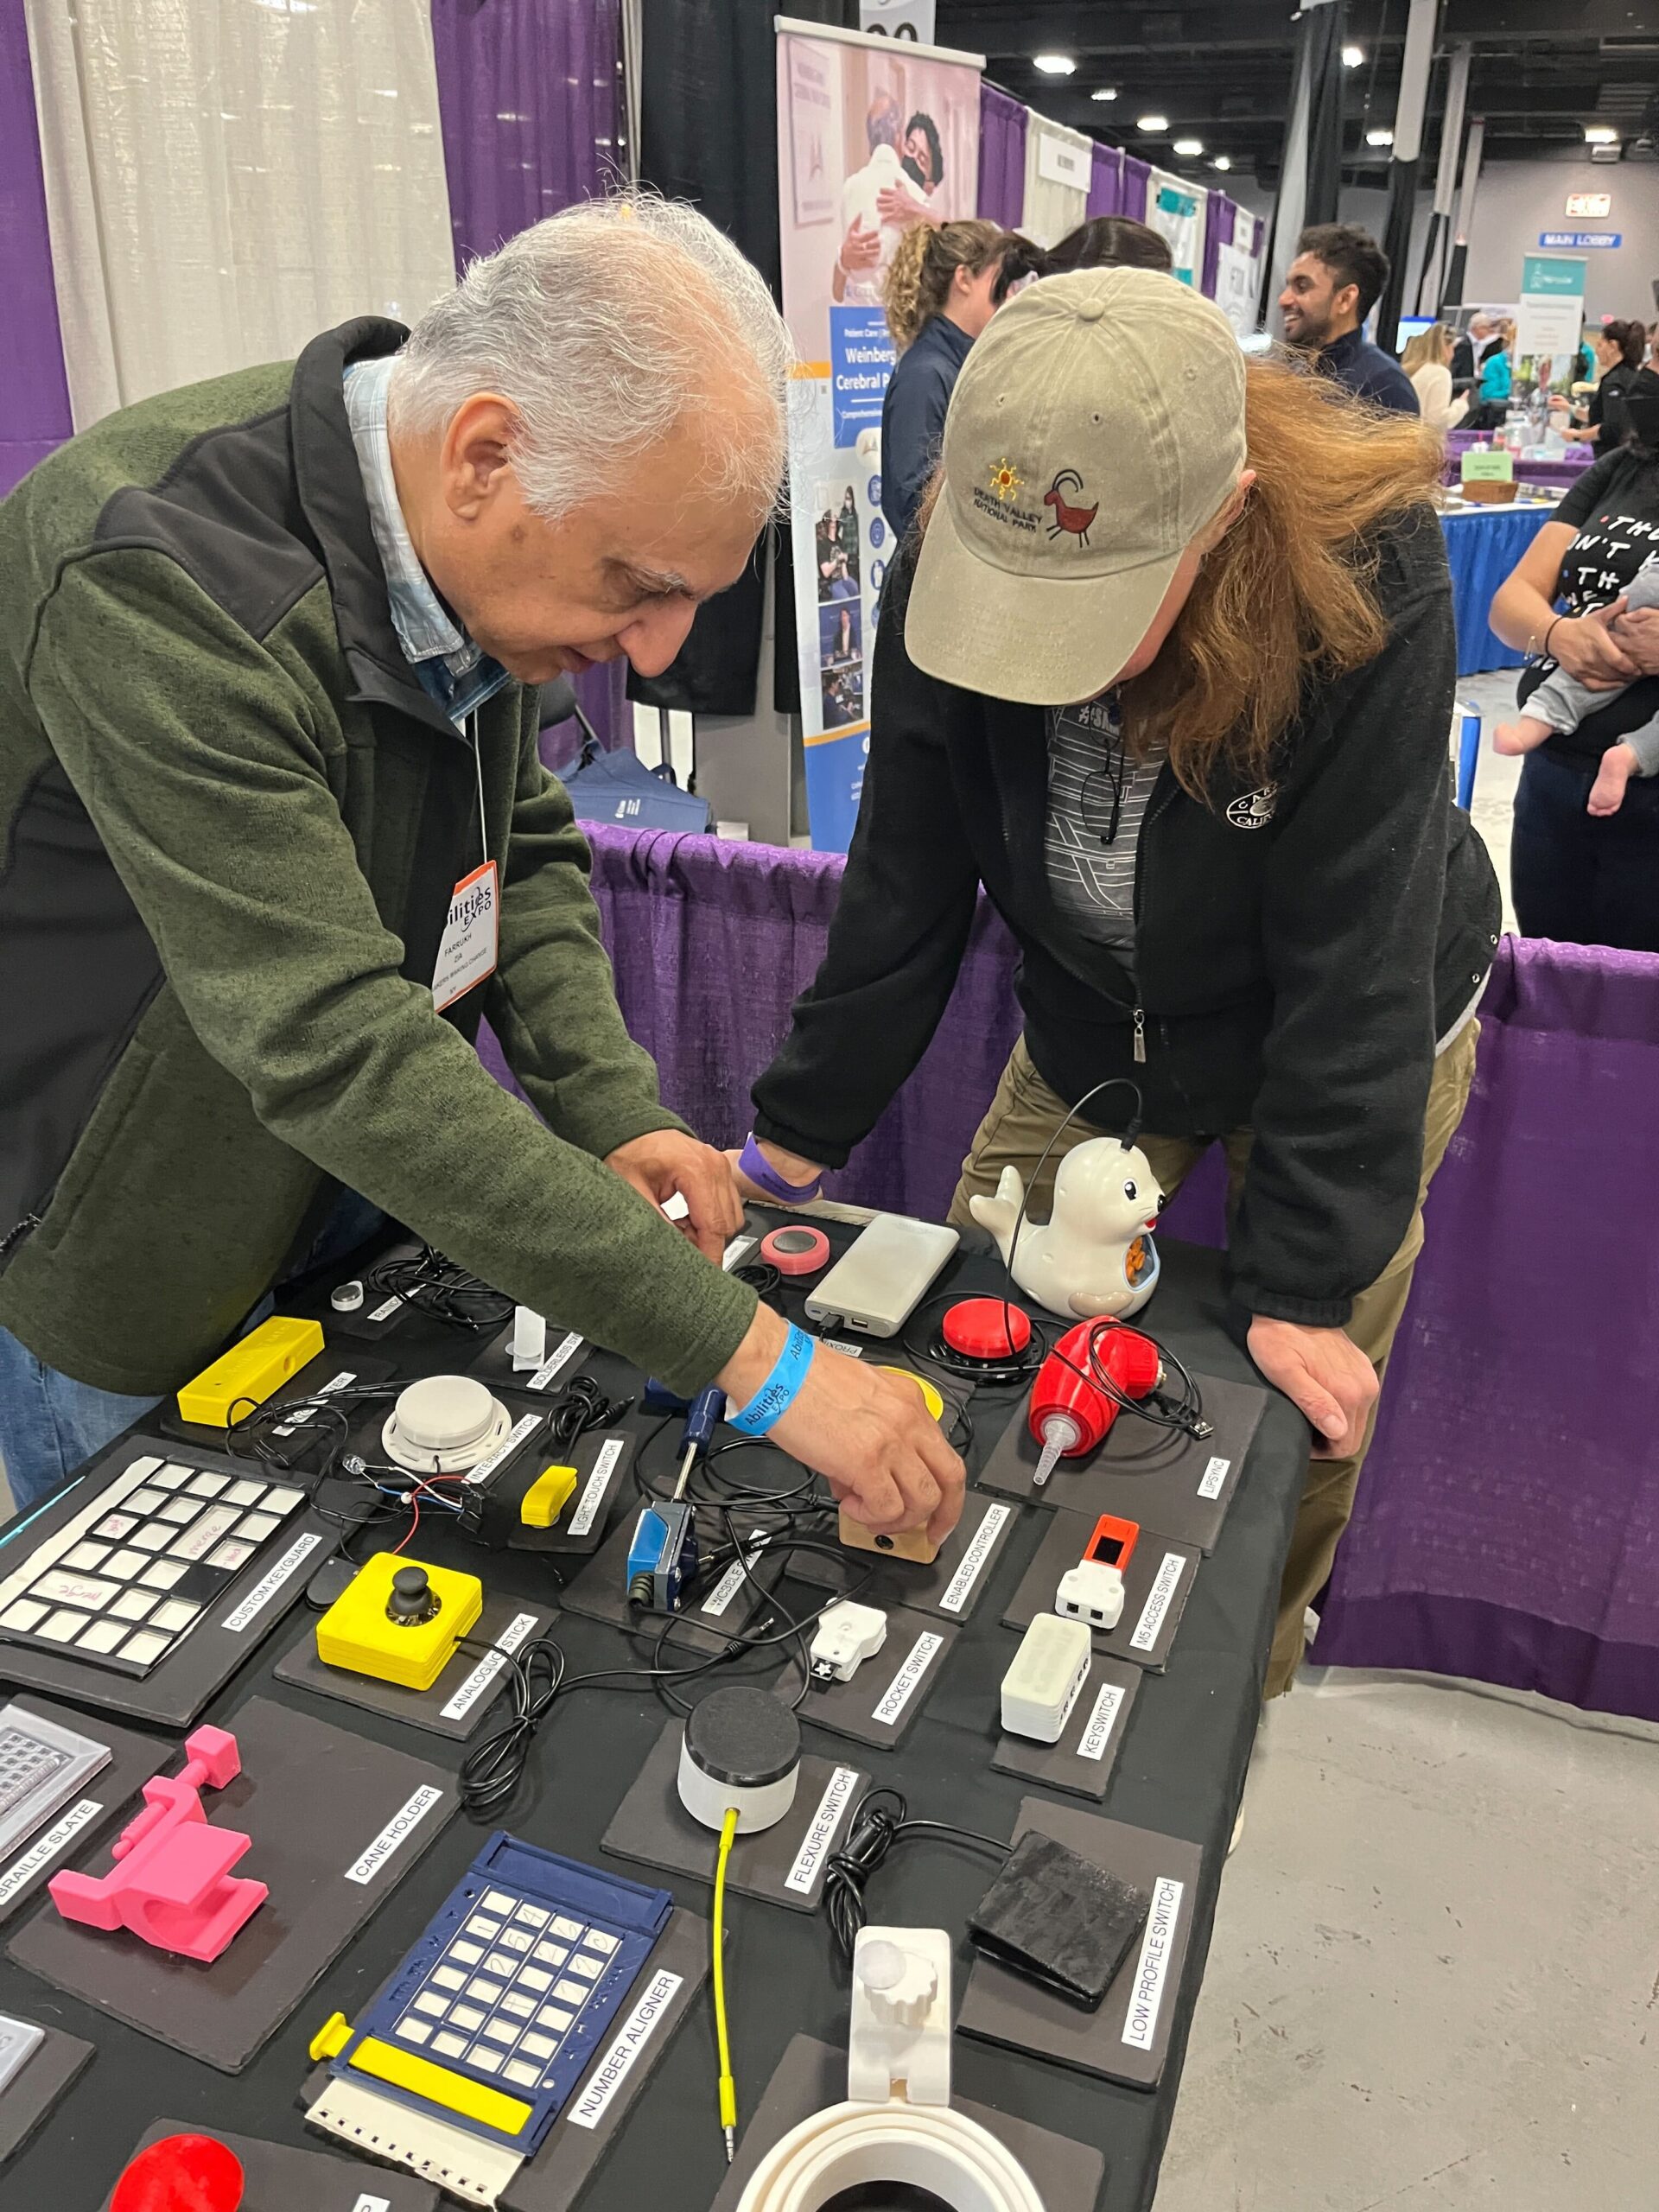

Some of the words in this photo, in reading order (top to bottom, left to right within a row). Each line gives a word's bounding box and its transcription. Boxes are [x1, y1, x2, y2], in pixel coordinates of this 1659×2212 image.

[1544, 234, 1573, 245] MAIN
[1577, 235, 1616, 246] LOBBY
[845, 346, 896, 365] Weinberg
[836, 372, 880, 390] Cerebral
[974, 487, 1001, 507] DEATH
[1003, 503, 1043, 524] VALLEY
[974, 499, 1007, 523] NATIONAL
[1013, 518, 1036, 532] PARK
[464, 900, 492, 925] EXPO
[533, 1343, 572, 1386] SOLDERLESS
[745, 1383, 784, 1426] Abilities
[771, 1389, 790, 1412] EXPO
[506, 1416, 537, 1443] SWITCH
[575, 1503, 590, 1530] LIGHT
[586, 1474, 603, 1509] TOUCH
[598, 1445, 617, 1476] SWITCH
[1203, 1460, 1224, 1493] LIPSYNC
[946, 1564, 976, 1605] ENABLED
[968, 1508, 1003, 1563] CONTROLLER
[1157, 1559, 1179, 1593] SWITCH
[230, 1586, 272, 1627] CUSTOM
[267, 1536, 315, 1585] KEYGUARD
[1143, 1593, 1166, 1630] ACCESS
[1137, 1630, 1151, 1645] M5
[453, 1667, 493, 1711] ANALOG
[880, 1674, 913, 1716] ROCKET
[906, 1635, 938, 1674] SWITCH
[1084, 1691, 1117, 1753] KEYSWITCH
[48, 1803, 93, 1844] SLATE
[355, 1839, 392, 1876] CANE
[386, 1789, 435, 1839] HOLDER
[793, 1822, 830, 1884] FLEXURE
[821, 1773, 851, 1821] SWITCH
[1153, 1881, 1175, 1936] SWITCH
[1138, 1937, 1164, 2002] PROFILE
[1129, 2004, 1151, 2041] LOW
[579, 2045, 632, 2118] NUMBER
[626, 1976, 675, 2044] ALIGNER
